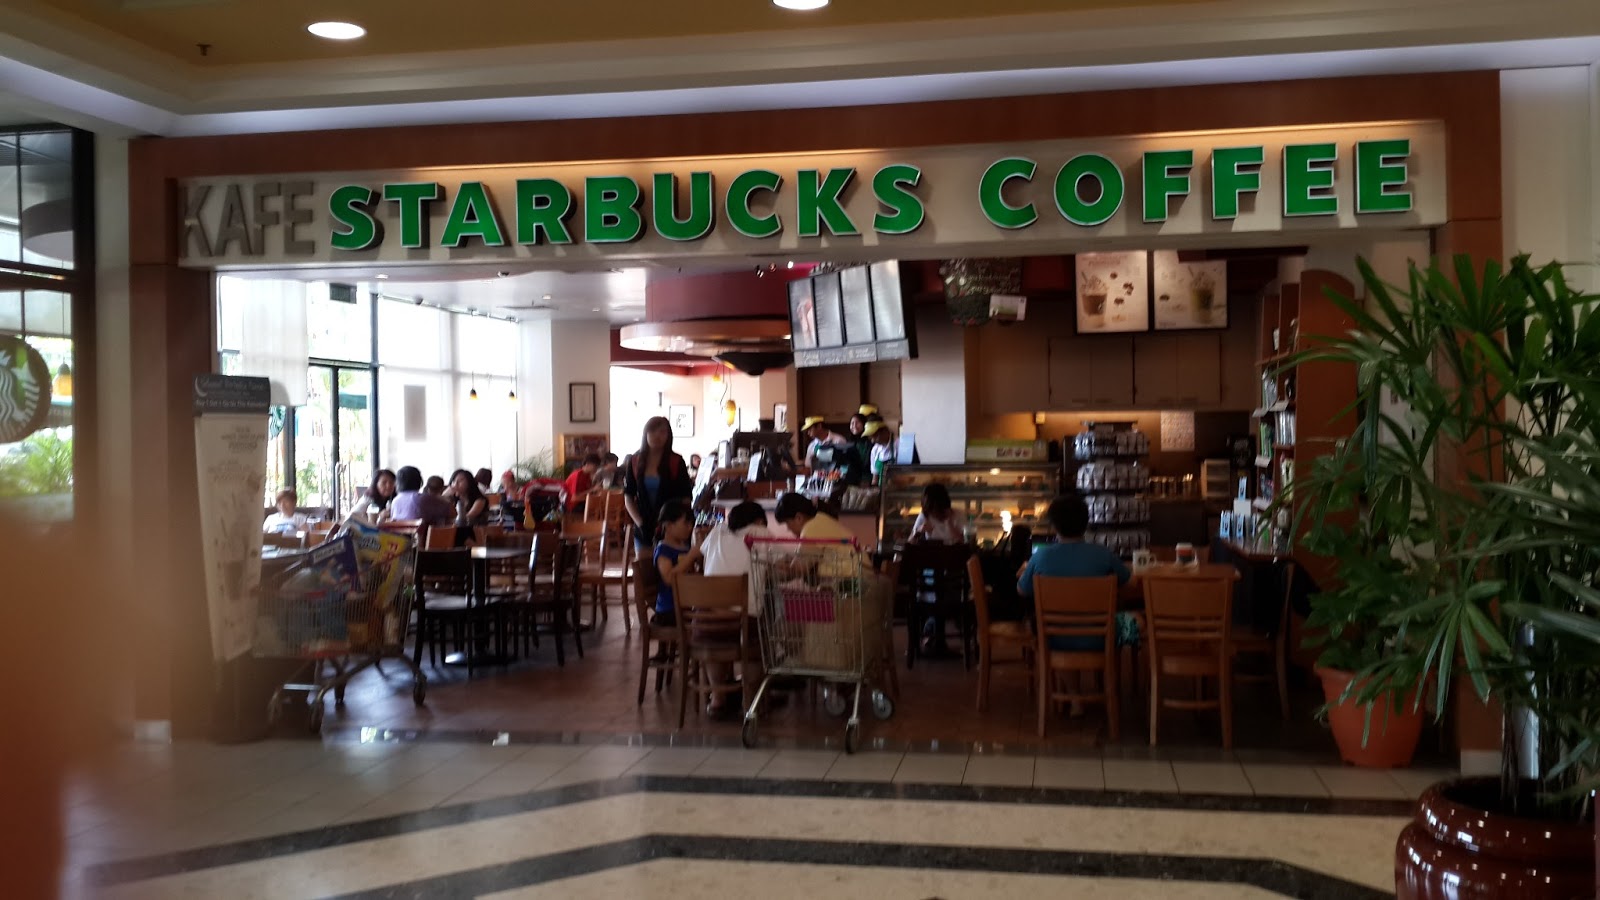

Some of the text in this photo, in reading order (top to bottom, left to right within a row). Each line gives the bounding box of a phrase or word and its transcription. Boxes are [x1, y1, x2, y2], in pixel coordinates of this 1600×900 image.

[184, 139, 1412, 257] KAFE STARBUCKS COFFEE
